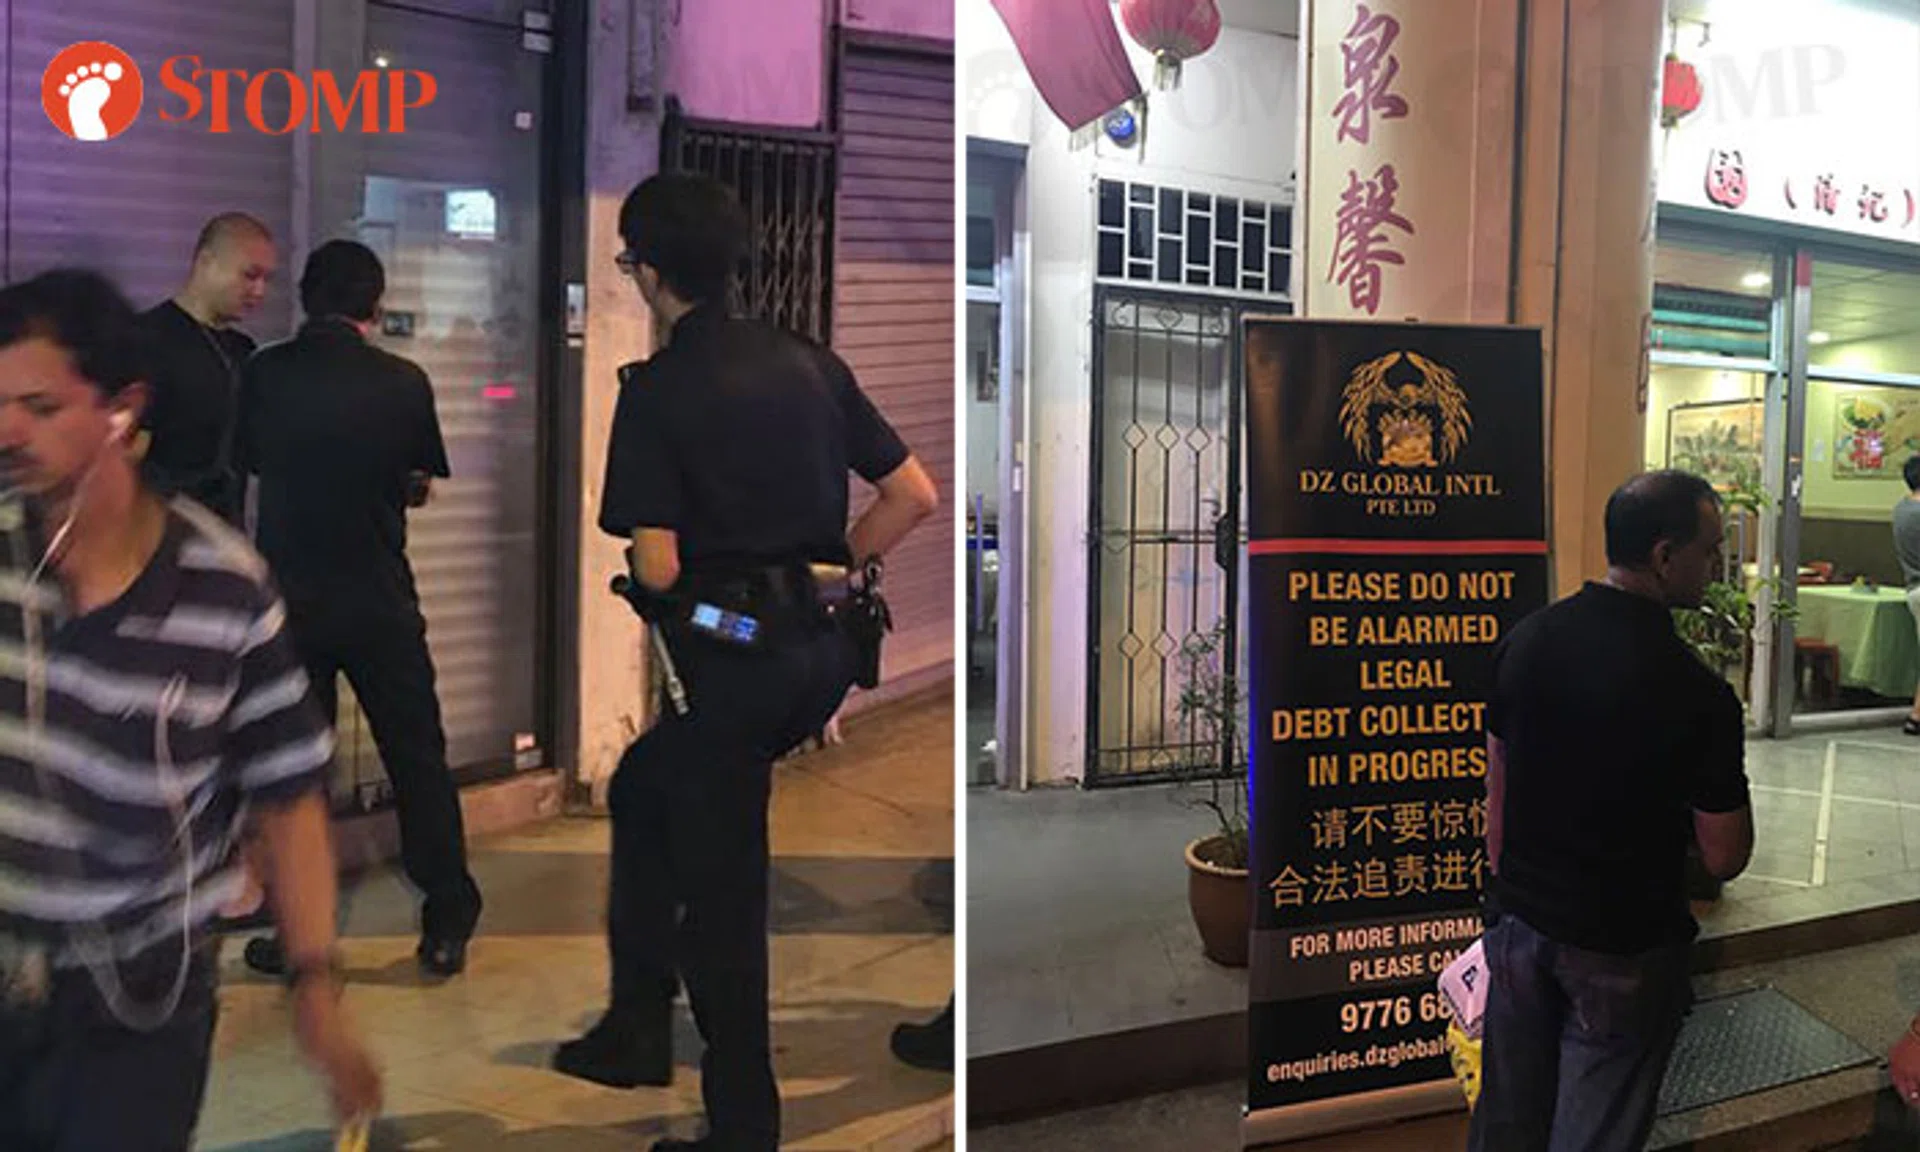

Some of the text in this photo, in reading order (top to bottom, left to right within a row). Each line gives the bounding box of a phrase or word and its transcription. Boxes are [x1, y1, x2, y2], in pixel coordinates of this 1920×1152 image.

[1299, 470, 1501, 496] DZ GLOBAL INTL
[1366, 499, 1436, 516] PTE LTD
[1289, 571, 1515, 601] PLEASE DO NOT
[1309, 613, 1499, 646] BE ALARMED
[1360, 658, 1451, 690] LEGAL
[1272, 707, 1351, 741] DEBT
[1308, 755, 1338, 787] IN
[1290, 933, 1330, 960] FOR
[1336, 926, 1396, 951] MORE
[1350, 953, 1424, 983] PLEASE
[1340, 996, 1412, 1033] 9776
